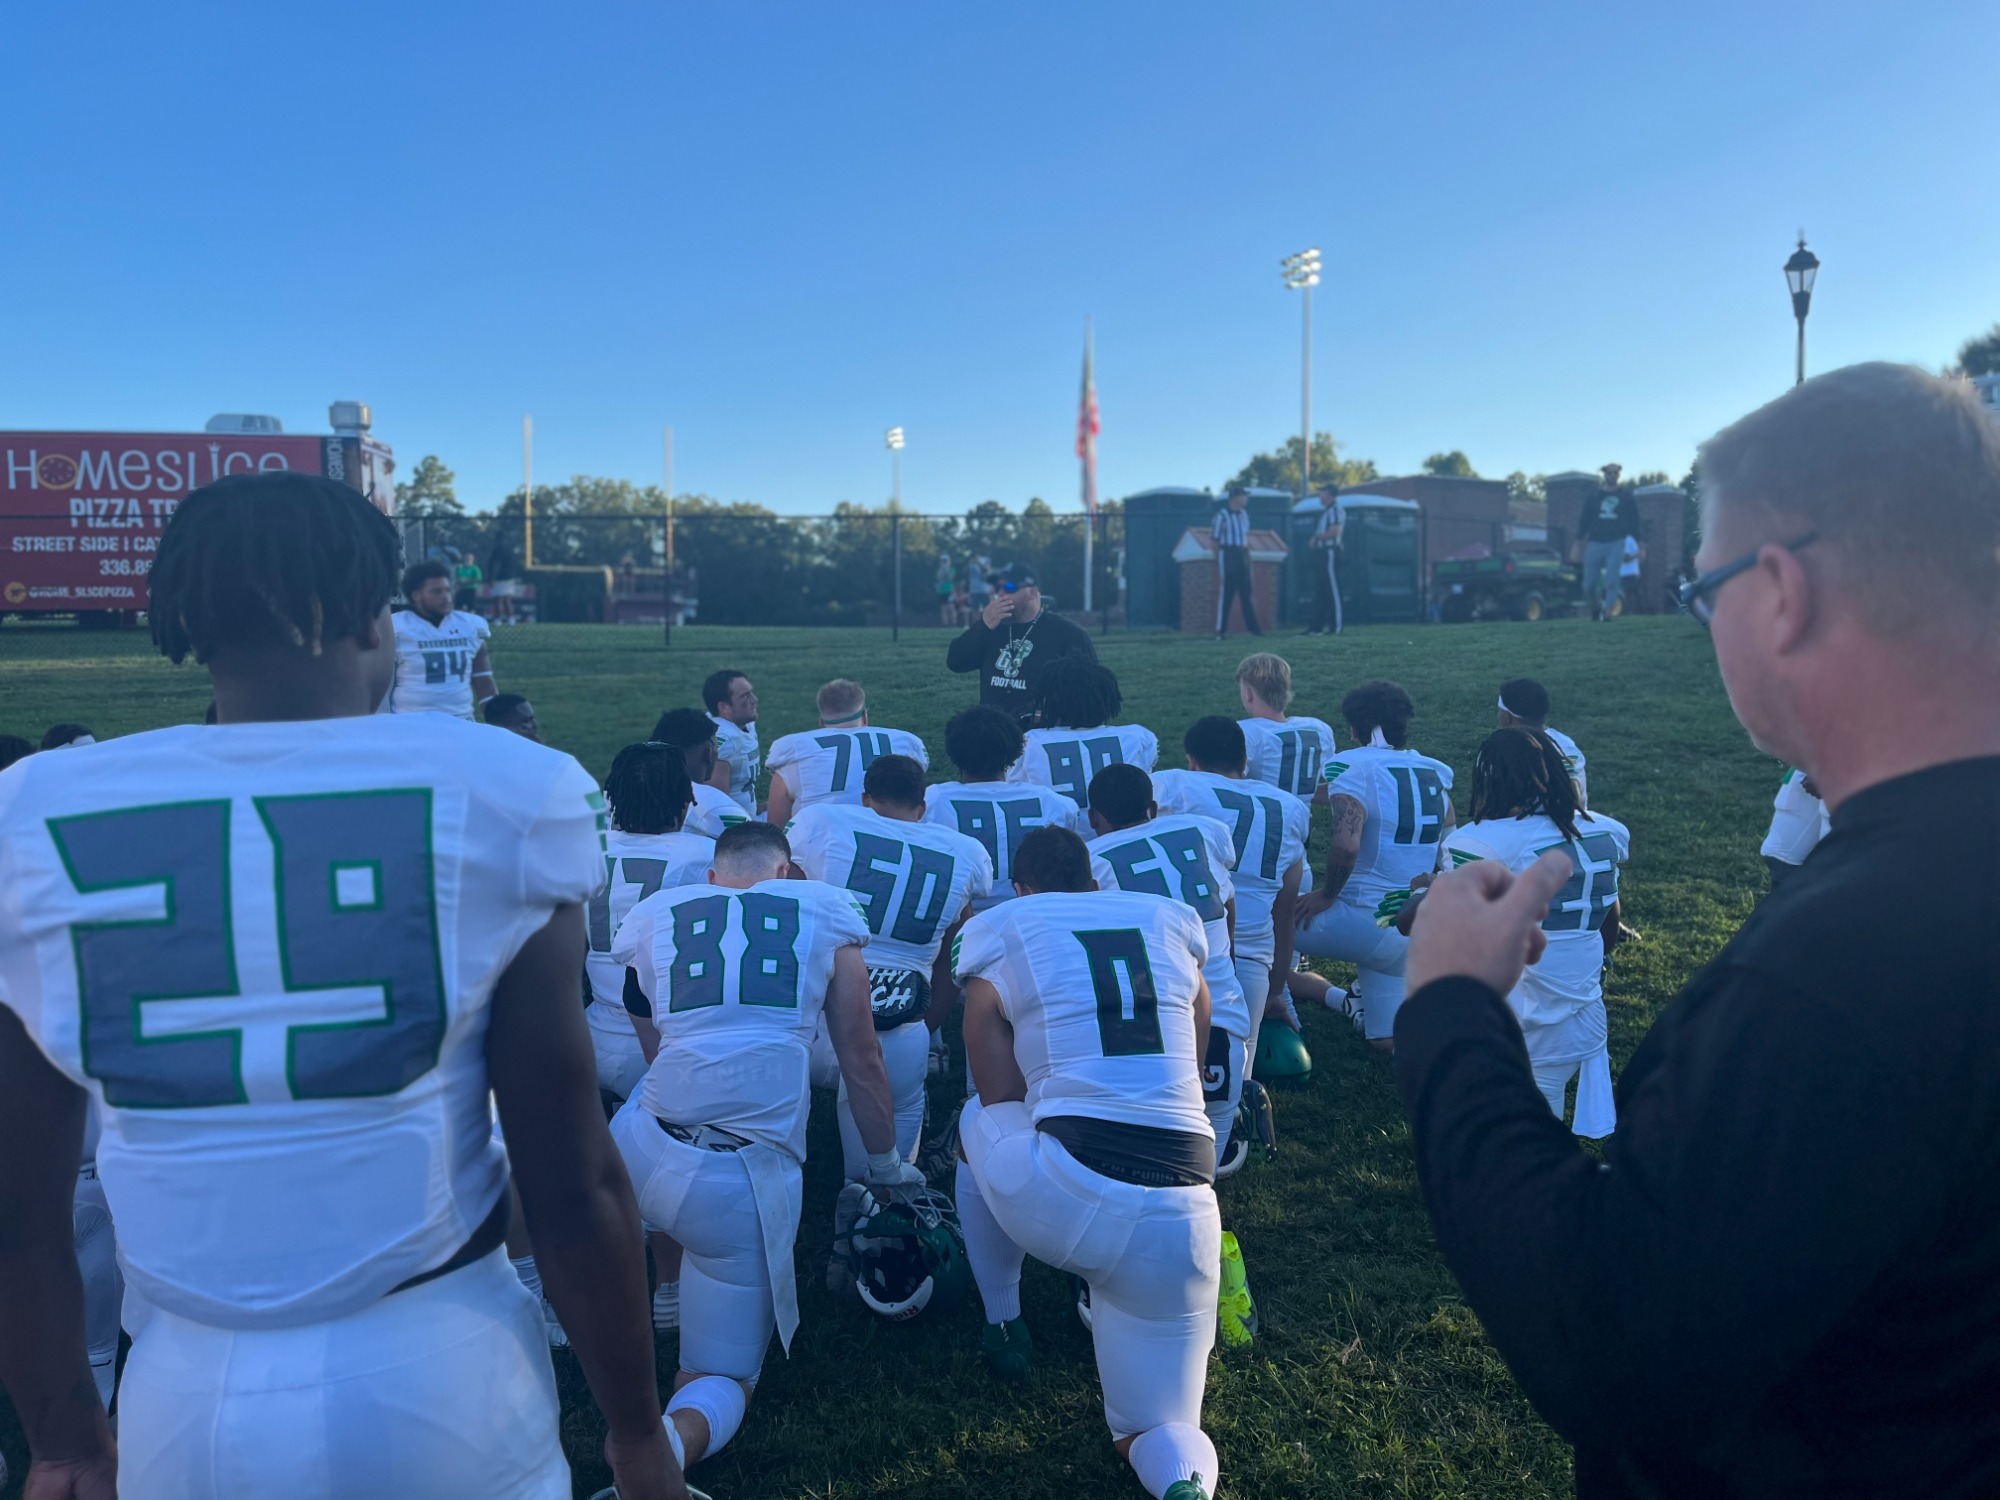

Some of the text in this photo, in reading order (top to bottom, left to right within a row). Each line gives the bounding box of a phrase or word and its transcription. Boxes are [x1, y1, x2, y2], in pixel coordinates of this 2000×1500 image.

[12, 536, 76, 553] STREET
[80, 536, 120, 552] SIDE
[70, 498, 145, 529] PIZZA
[814, 732, 893, 792] 74
[1275, 730, 1322, 795] 10
[1212, 787, 1283, 880] 71
[1386, 767, 1445, 844] 19
[845, 830, 955, 945] 50
[45, 787, 447, 1110] 29
[669, 892, 801, 1014] 88
[1073, 926, 1166, 1057] 0
